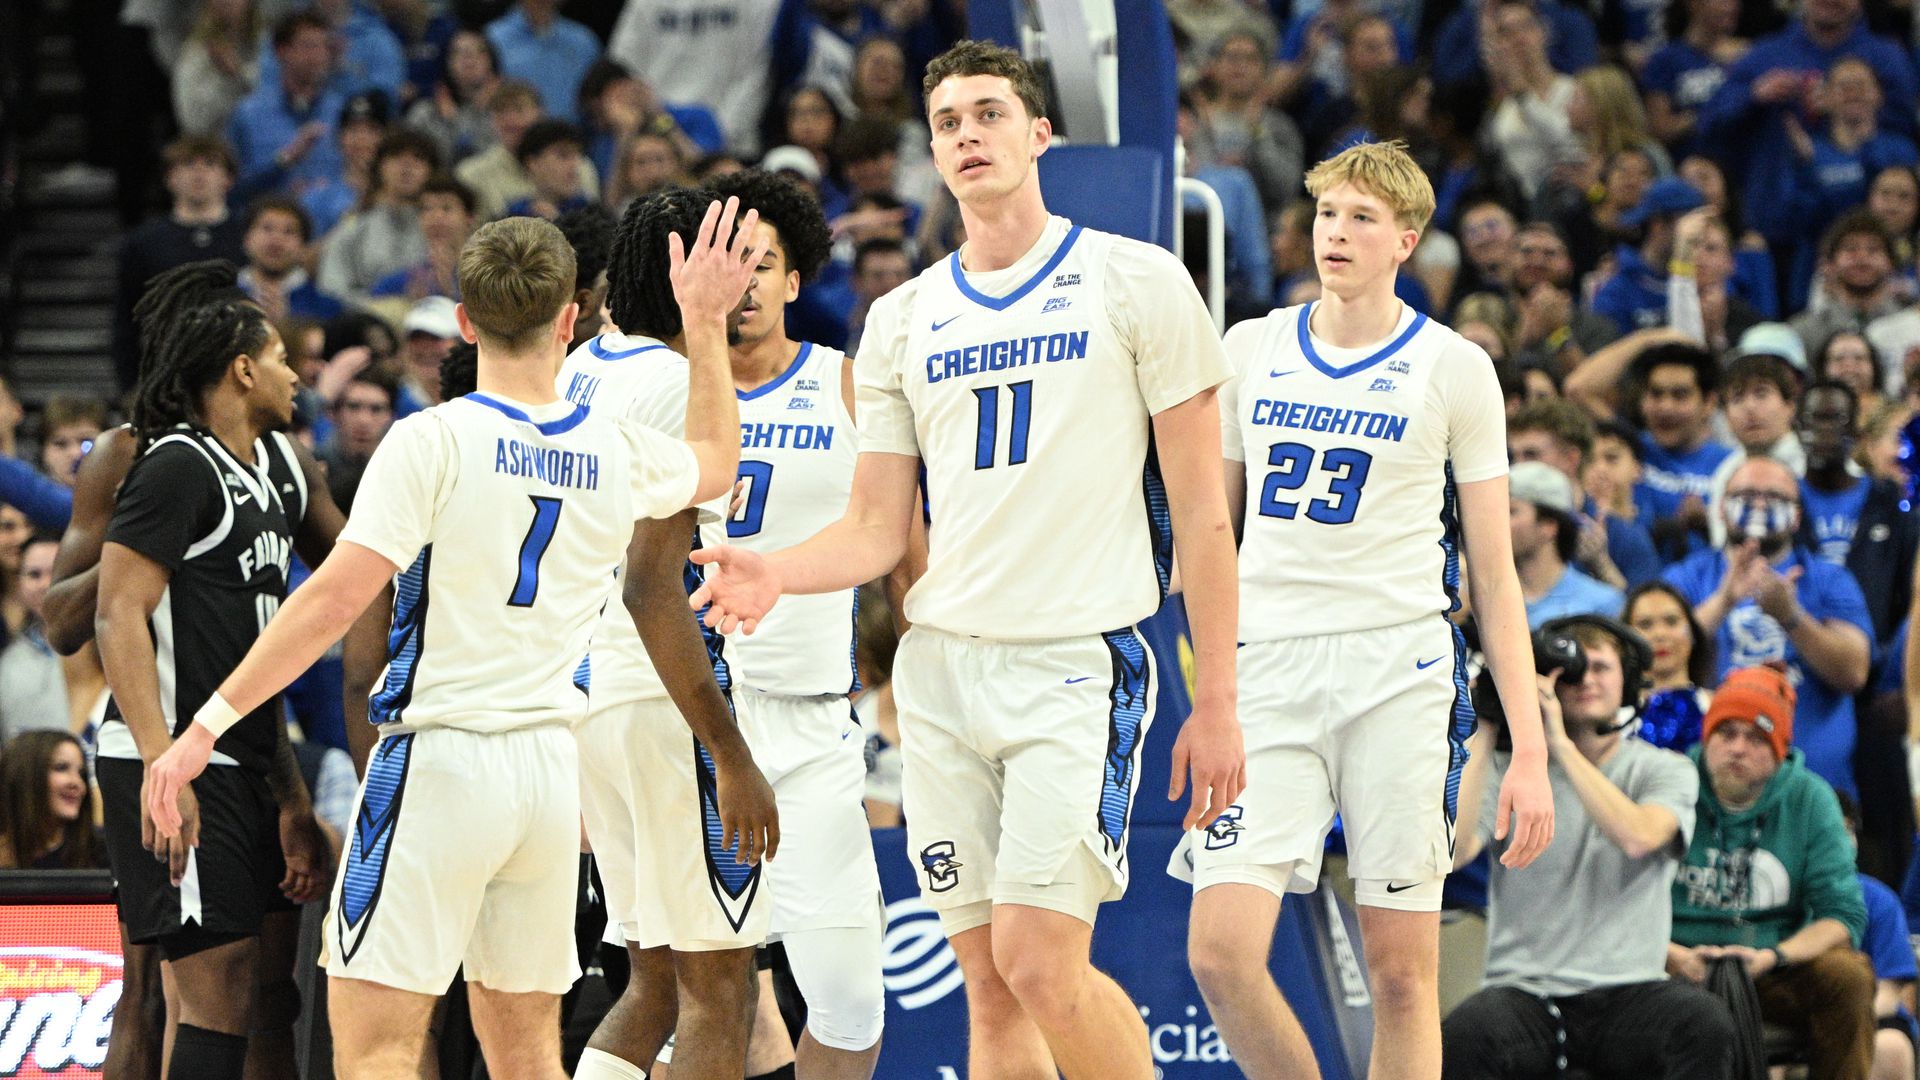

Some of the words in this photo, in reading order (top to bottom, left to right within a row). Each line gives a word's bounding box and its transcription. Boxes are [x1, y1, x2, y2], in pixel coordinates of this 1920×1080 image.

[1053, 279, 1081, 289] CHANGE
[1056, 274, 1066, 282] BE
[1042, 301, 1073, 311] EAST
[926, 330, 1089, 384] CREIGHTON
[564, 371, 603, 408] NEAL
[971, 379, 1034, 471] 11
[1251, 399, 1409, 442] CREIGHTON
[495, 438, 599, 491] ASHWORTH
[1259, 441, 1373, 525] 23
[507, 494, 564, 608] 1
